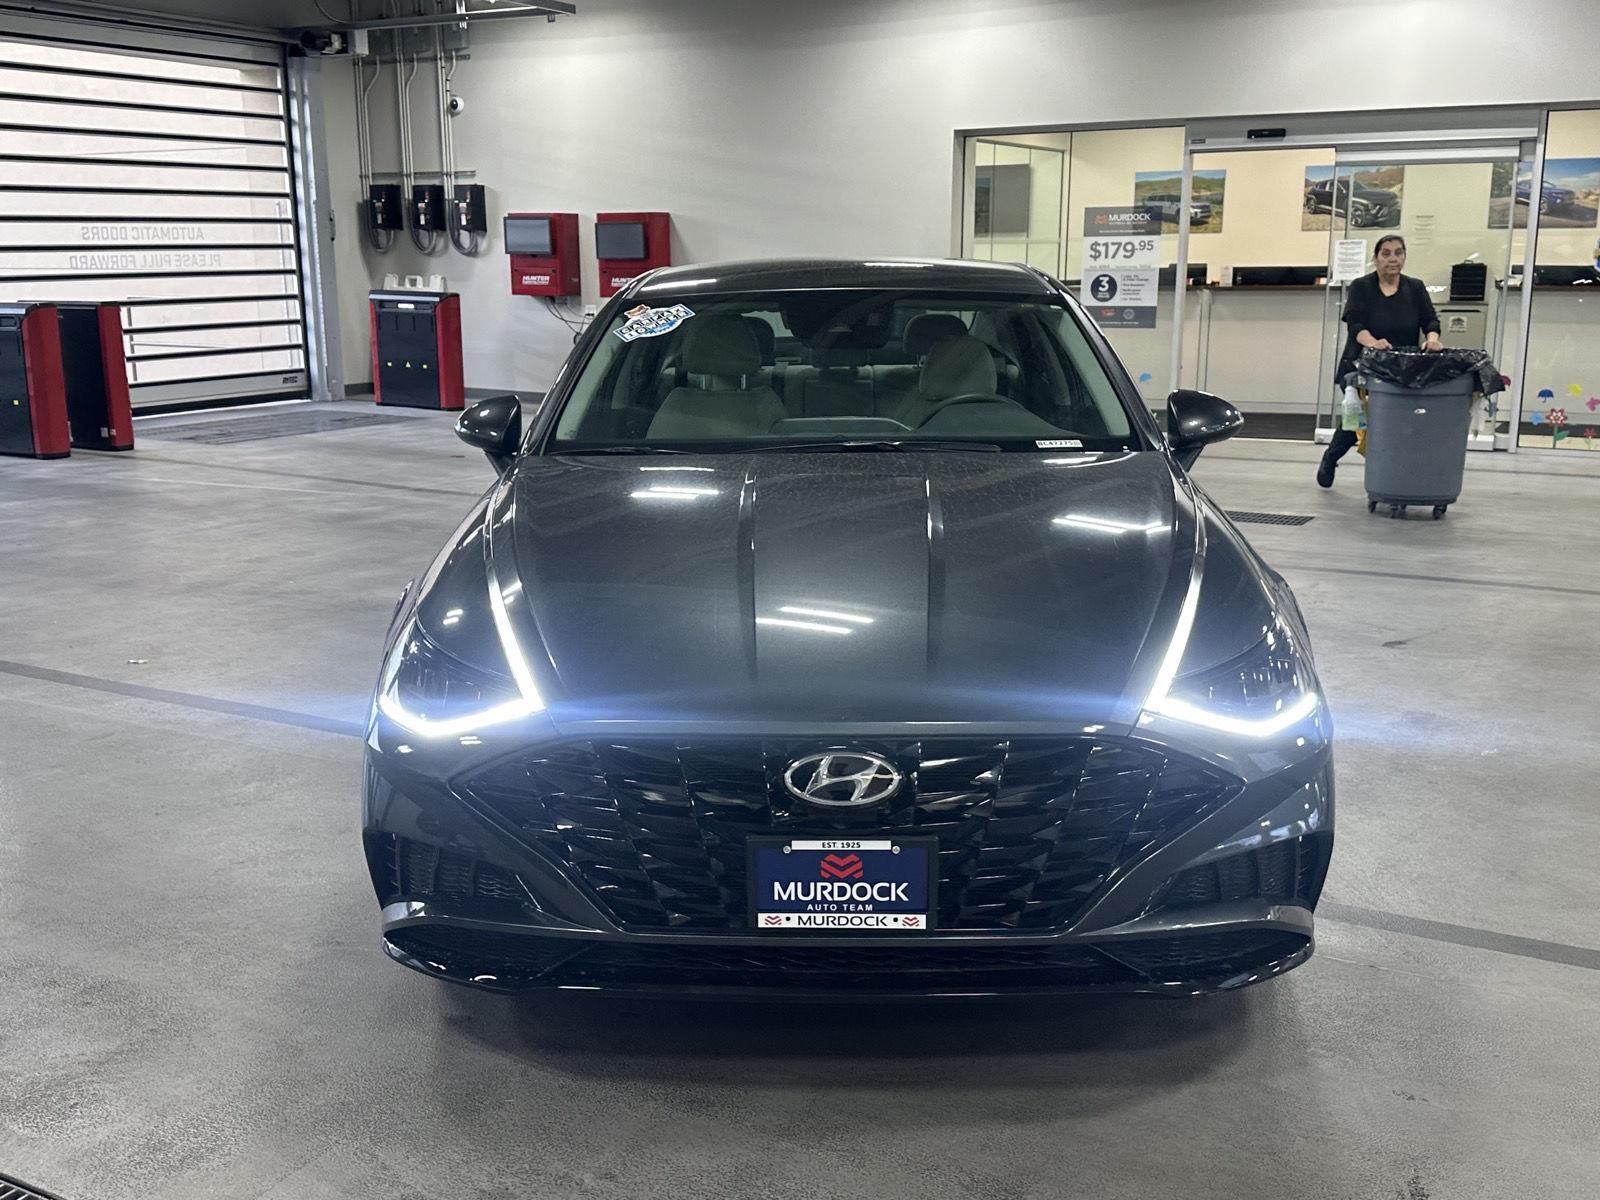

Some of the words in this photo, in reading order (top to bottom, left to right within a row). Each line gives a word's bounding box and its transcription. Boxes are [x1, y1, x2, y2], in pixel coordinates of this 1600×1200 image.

[1108, 213, 1151, 221] MURDOCK
[1098, 276, 1109, 292] 3
[822, 841, 840, 849] EST.
[841, 841, 861, 849] 1925
[773, 881, 909, 902] MURDOCK
[806, 903, 838, 912] AUTO
[844, 903, 874, 912] TEAM
[797, 915, 889, 927] MURDOCK
